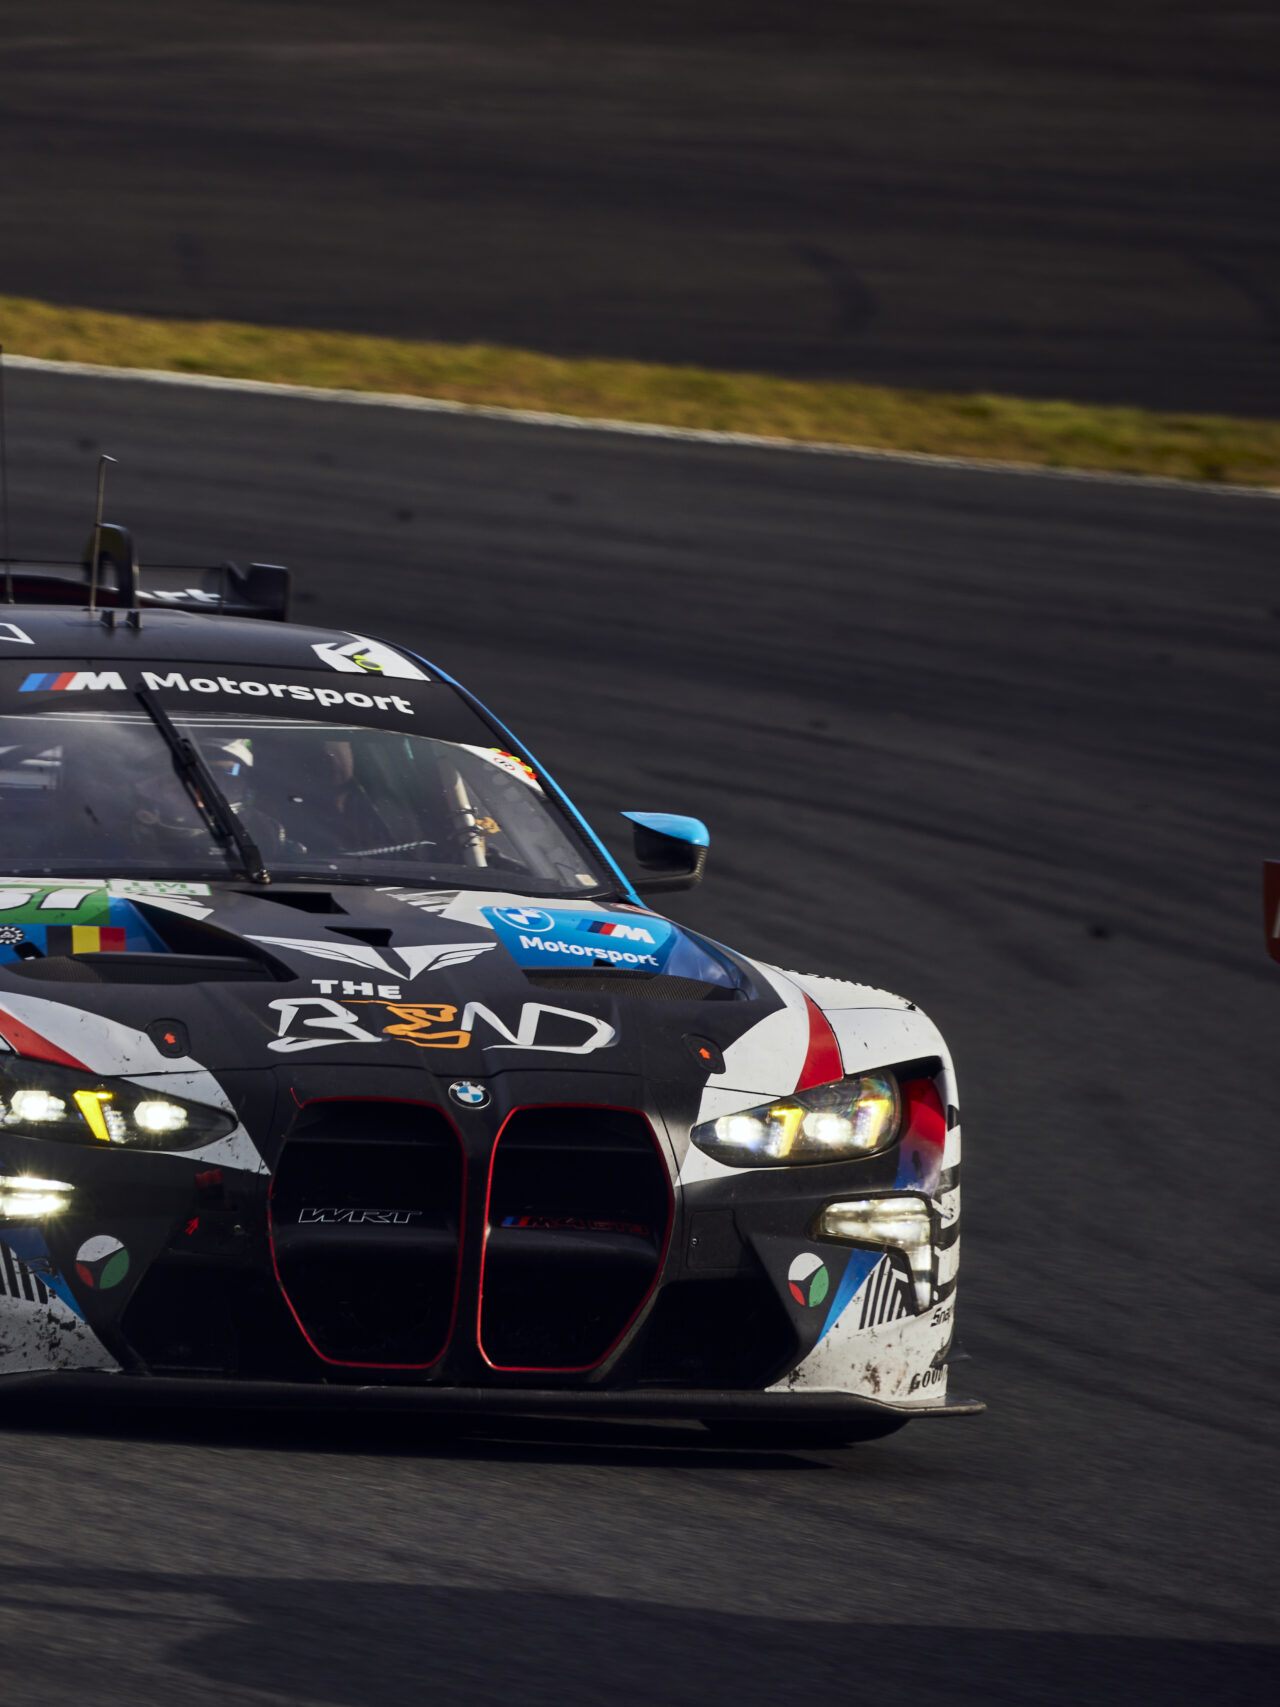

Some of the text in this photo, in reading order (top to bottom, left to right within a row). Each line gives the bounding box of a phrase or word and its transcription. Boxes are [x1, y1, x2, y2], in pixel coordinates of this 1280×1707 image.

[65, 671, 415, 715] M Motorsport
[609, 923, 656, 945] M
[519, 935, 660, 967] Motorsport
[311, 978, 403, 1000] THE
[298, 1207, 423, 1224] WRT
